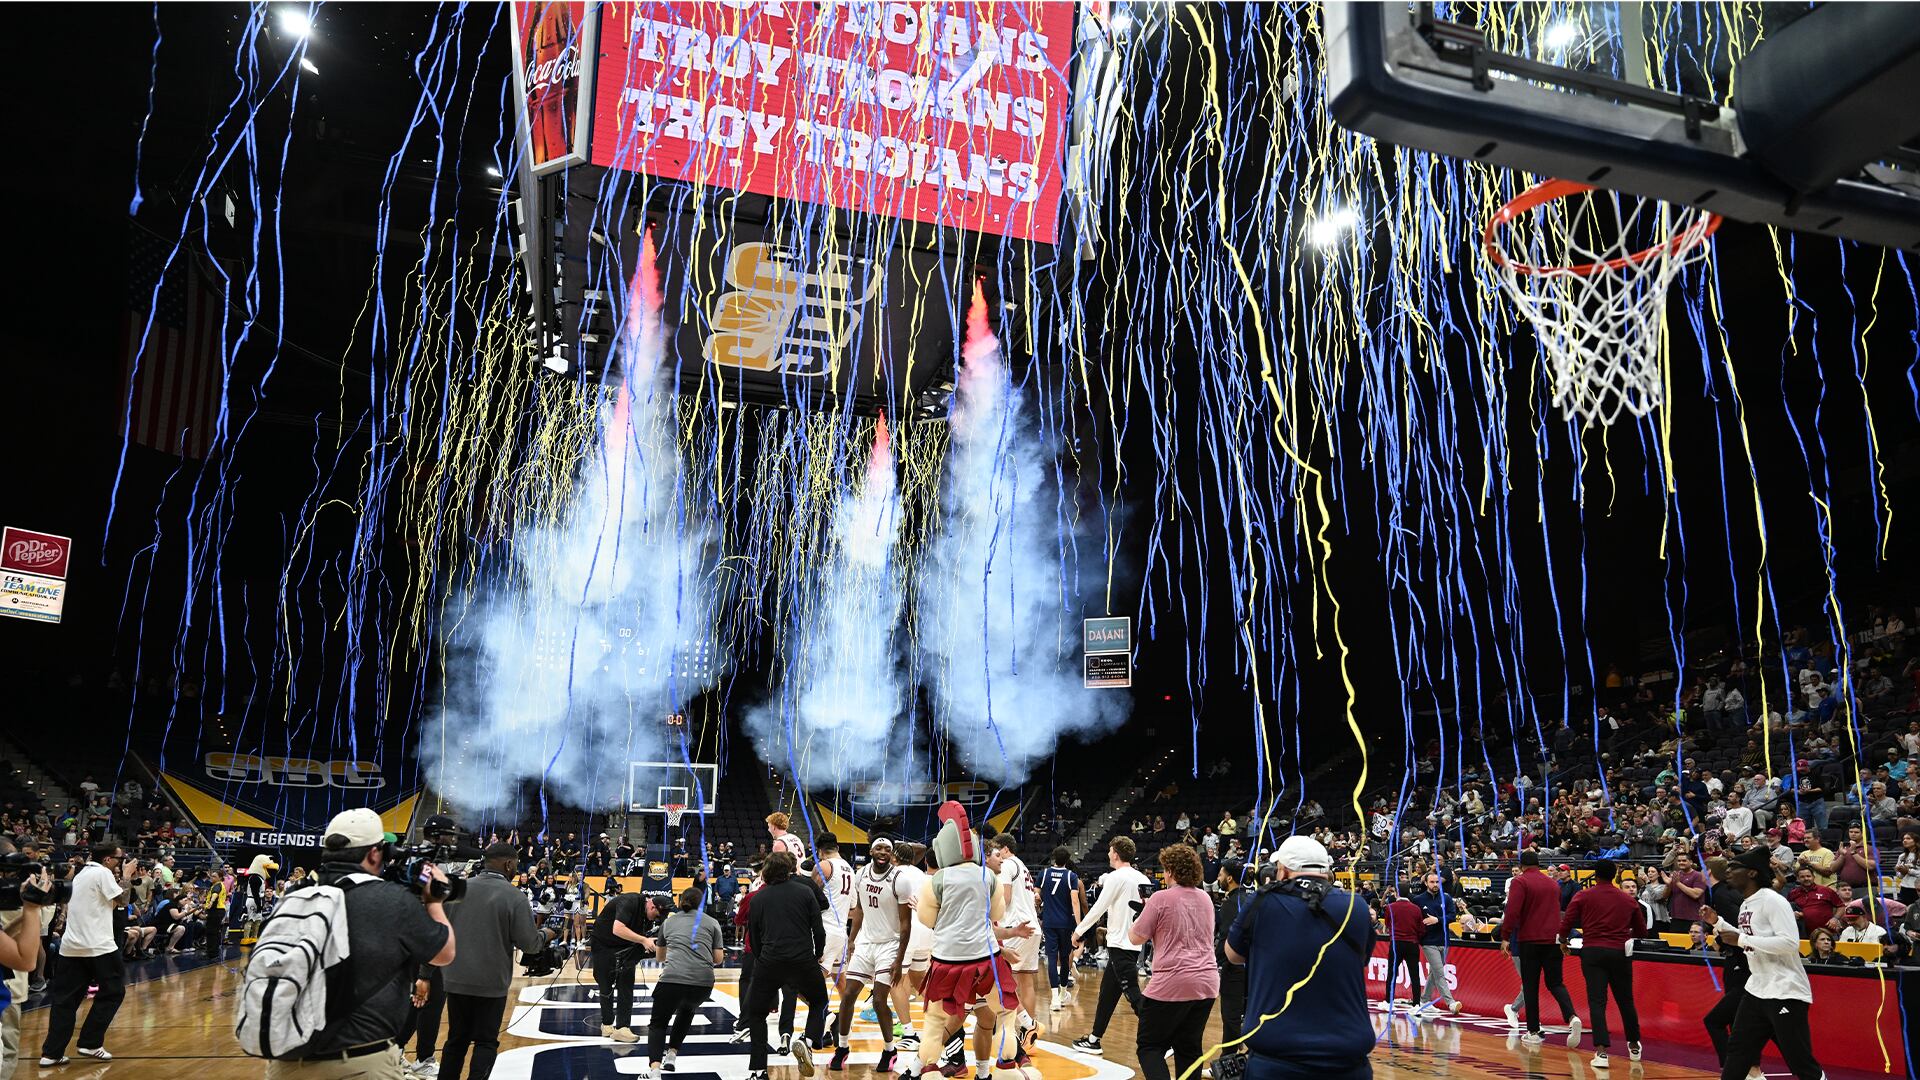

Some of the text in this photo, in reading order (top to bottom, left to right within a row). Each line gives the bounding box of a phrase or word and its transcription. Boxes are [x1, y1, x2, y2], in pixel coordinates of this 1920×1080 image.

[631, 15, 1046, 139] TROY TROJANS
[625, 88, 1039, 203] TROY TROJANS
[14, 541, 59, 564] Pepper
[29, 540, 48, 551] Dr
[4, 581, 35, 593] TEAM
[37, 586, 61, 597] ONE
[1088, 627, 1124, 643] DASANI
[250, 832, 316, 848] LEGENDS
[793, 843, 803, 858] 3
[840, 873, 851, 895] 11
[866, 883, 884, 895] TROY
[1051, 878, 1061, 895] 7
[868, 895, 879, 908] 10
